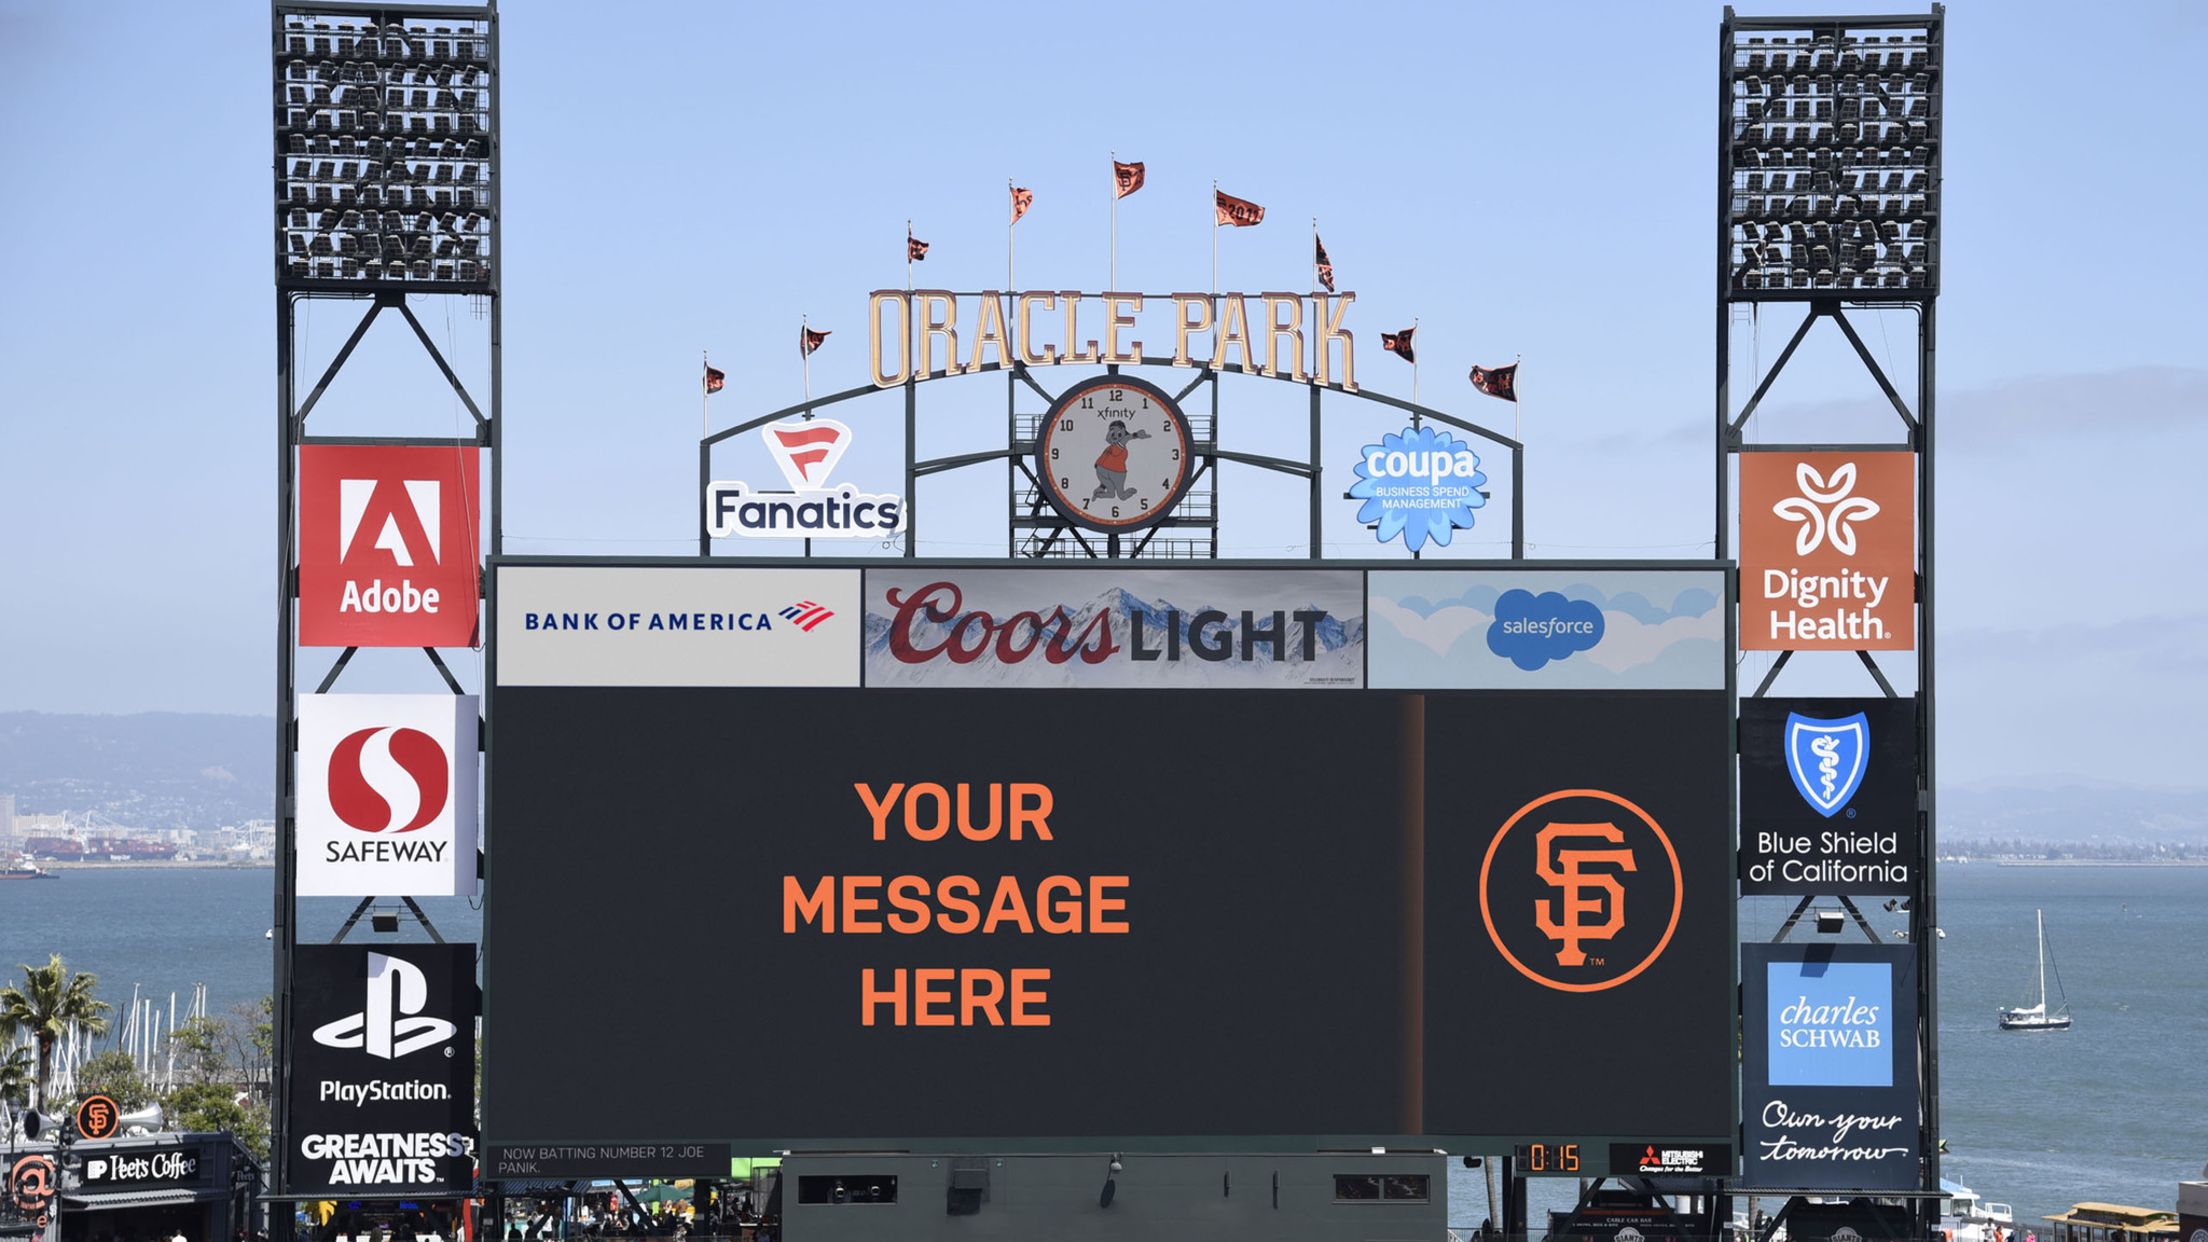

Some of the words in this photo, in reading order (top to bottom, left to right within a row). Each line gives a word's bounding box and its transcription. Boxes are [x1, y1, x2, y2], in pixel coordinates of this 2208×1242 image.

[869, 289, 1142, 389] ORACLE
[1171, 291, 1359, 393] PARK
[1081, 398, 1093, 409] 11
[1109, 390, 1123, 401] 12
[1143, 398, 1148, 409] 1
[1098, 406, 1136, 420] xfinity
[1060, 419, 1074, 431] 10
[1163, 420, 1171, 432] 2
[1051, 448, 1059, 460] 9
[1172, 449, 1180, 460] 3
[1367, 450, 1476, 487] coupa
[1061, 478, 1069, 489] 8
[1162, 478, 1170, 489] 4
[1376, 486, 1430, 497] BUSINESS
[1432, 486, 1470, 497] SPEND
[715, 490, 900, 530] Fanatics
[1083, 498, 1090, 510] 7
[1111, 506, 1119, 517] 6
[1140, 498, 1148, 510] 5
[1382, 499, 1463, 509] MANAGEMENT
[339, 579, 441, 614] Adobe
[1764, 568, 1889, 608] Dignity
[525, 613, 599, 631] BANK
[607, 613, 642, 631] OF
[648, 613, 772, 631] AMERICA
[886, 581, 1121, 665] Coors
[1130, 610, 1328, 662] LIGHT
[1503, 617, 1594, 639] salesforce
[853, 782, 1054, 842] YOUR
[326, 840, 448, 863] SAFEWAY
[1758, 831, 1812, 854] Blue
[1820, 831, 1897, 854] Shield
[1750, 860, 1775, 882] of
[1782, 859, 1908, 882] California
[783, 875, 1130, 934] MESSAGE
[862, 968, 1051, 1026] HERE
[1780, 996, 1880, 1025] charles
[1780, 1029, 1881, 1048] SCHWAB
[1762, 1100, 1825, 1128] Own
[1828, 1115, 1902, 1143] your
[301, 1132, 463, 1160] GREATNESS
[503, 1148, 535, 1160] NOW
[539, 1147, 596, 1160] BATTING
[600, 1147, 656, 1159] NUMBER
[662, 1146, 674, 1158] 12
[678, 1146, 704, 1158] JOE
[151, 1152, 197, 1179] Coffee
[1531, 1144, 1579, 1171] 0:15
[329, 1159, 436, 1185] AWAITS
[499, 1162, 541, 1174] PANIK.
